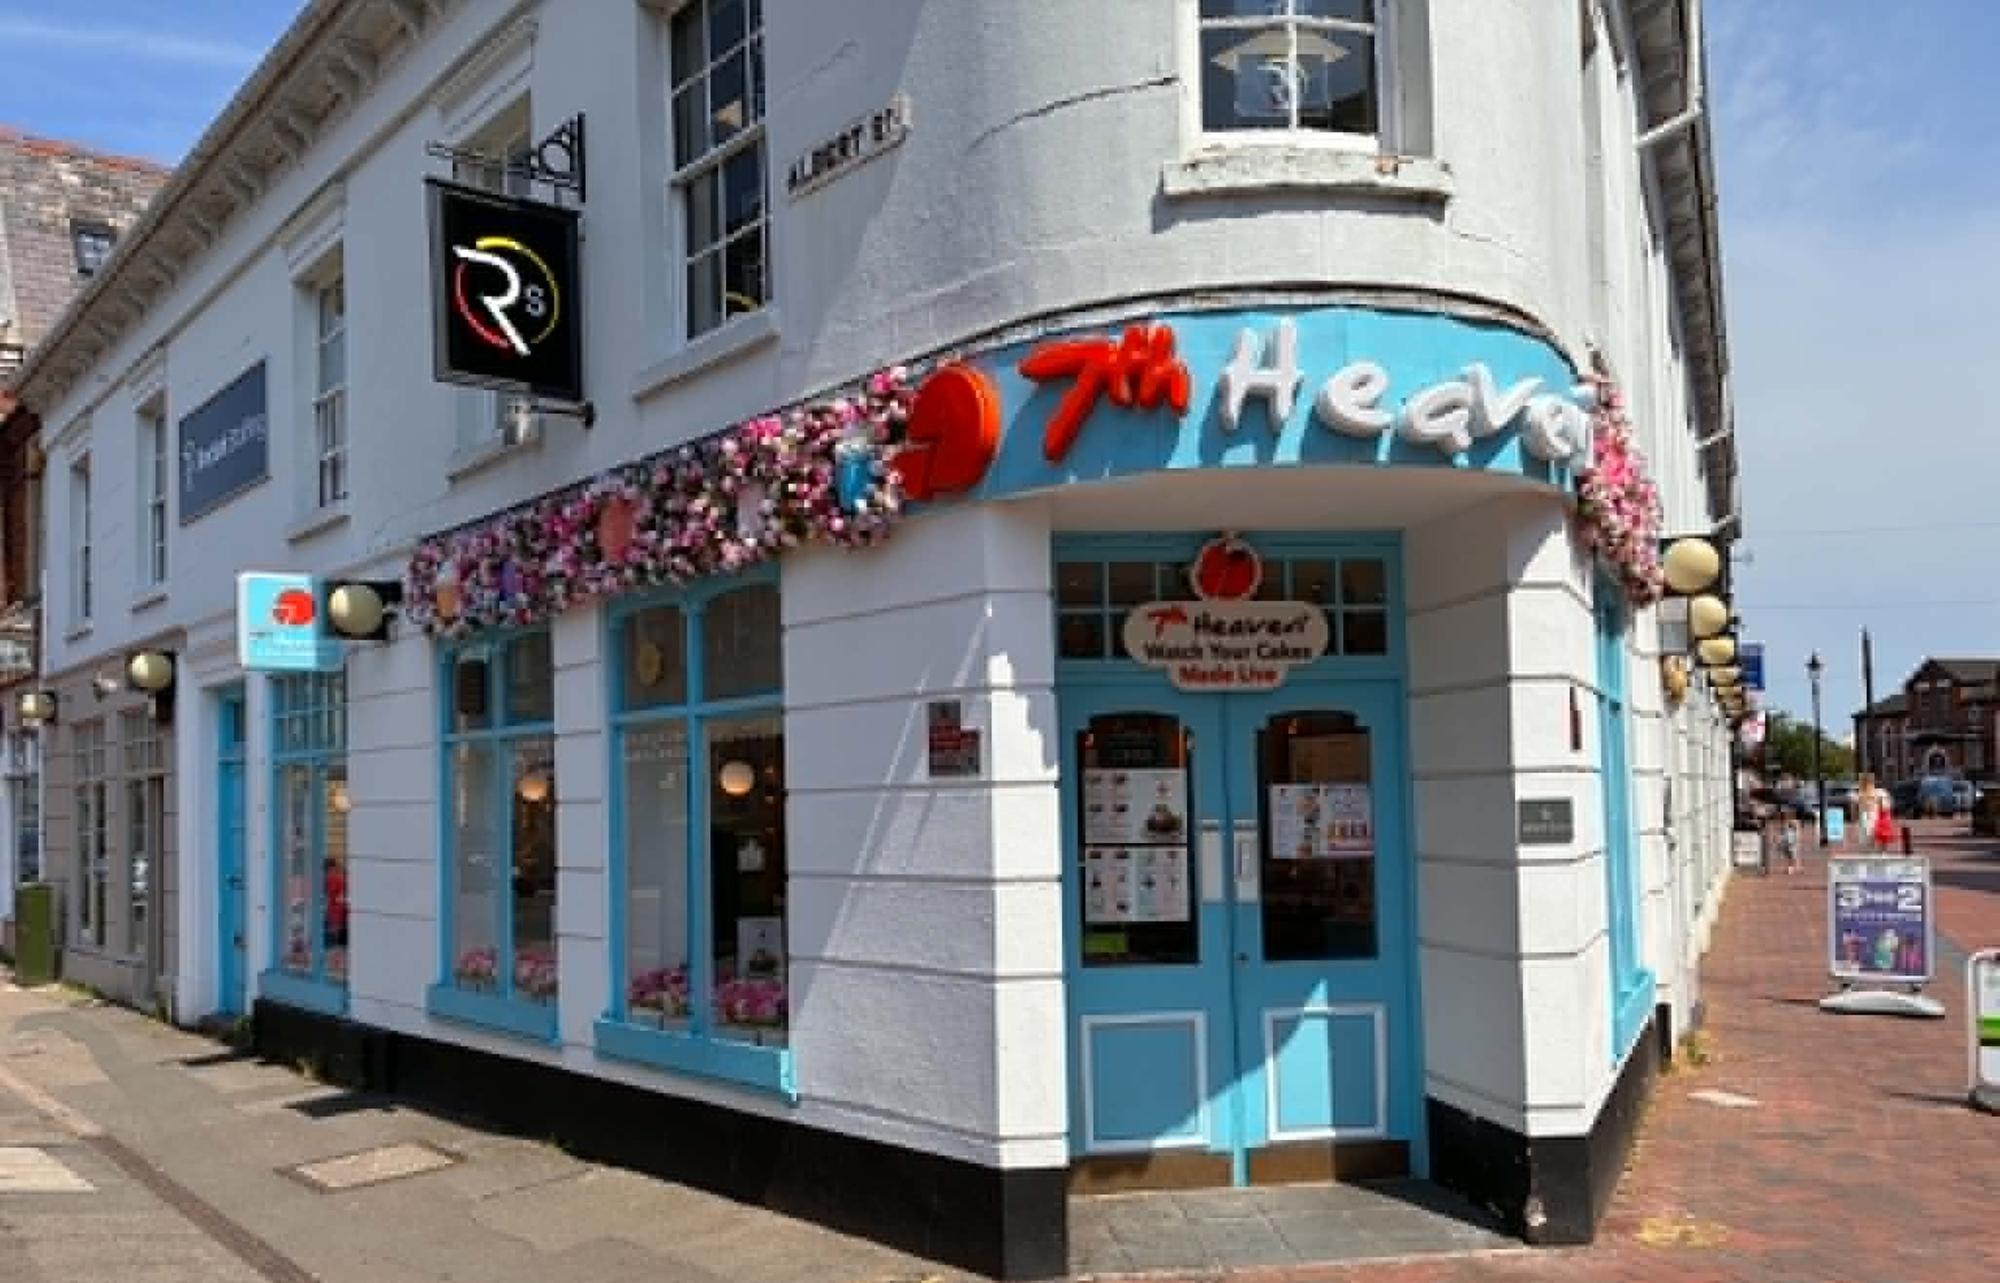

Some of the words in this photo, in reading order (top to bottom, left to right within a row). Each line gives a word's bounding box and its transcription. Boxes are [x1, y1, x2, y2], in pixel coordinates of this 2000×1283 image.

[787, 124, 863, 194] ALBERT
[1017, 320, 1193, 465] 7th
[1219, 314, 1594, 465] Heave
[1144, 642, 1204, 659] Watch
[1209, 642, 1250, 659] Your
[1256, 642, 1313, 659] Cakes
[1178, 665, 1235, 683] Made
[1238, 664, 1278, 683] Live
[1897, 886, 1922, 912] 2
